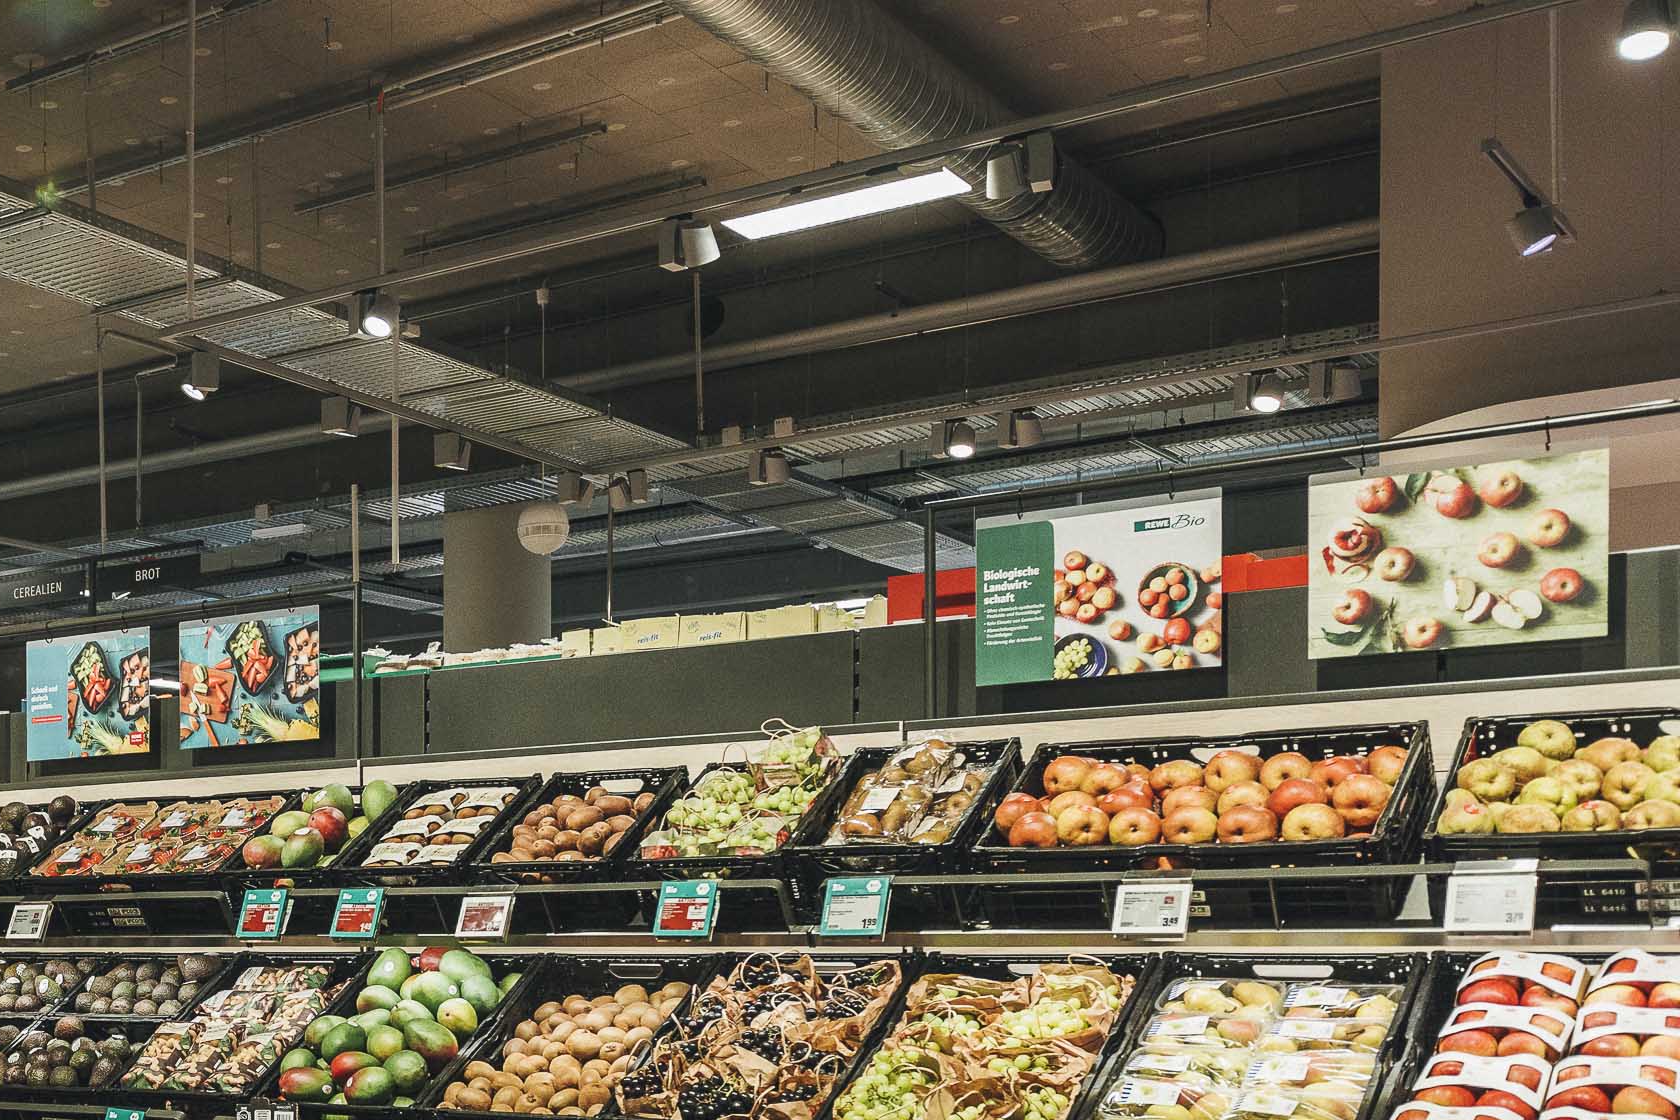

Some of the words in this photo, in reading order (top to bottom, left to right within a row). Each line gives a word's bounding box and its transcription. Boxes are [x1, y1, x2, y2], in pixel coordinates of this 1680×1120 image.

[1144, 519, 1170, 530] REWE
[1171, 514, 1205, 529] Bio
[135, 567, 161, 582] BROT
[983, 566, 1040, 581] Biologische
[13, 581, 62, 600] CEREALIEN
[983, 580, 1033, 593] Landwirt-
[983, 592, 1016, 605] schaft
